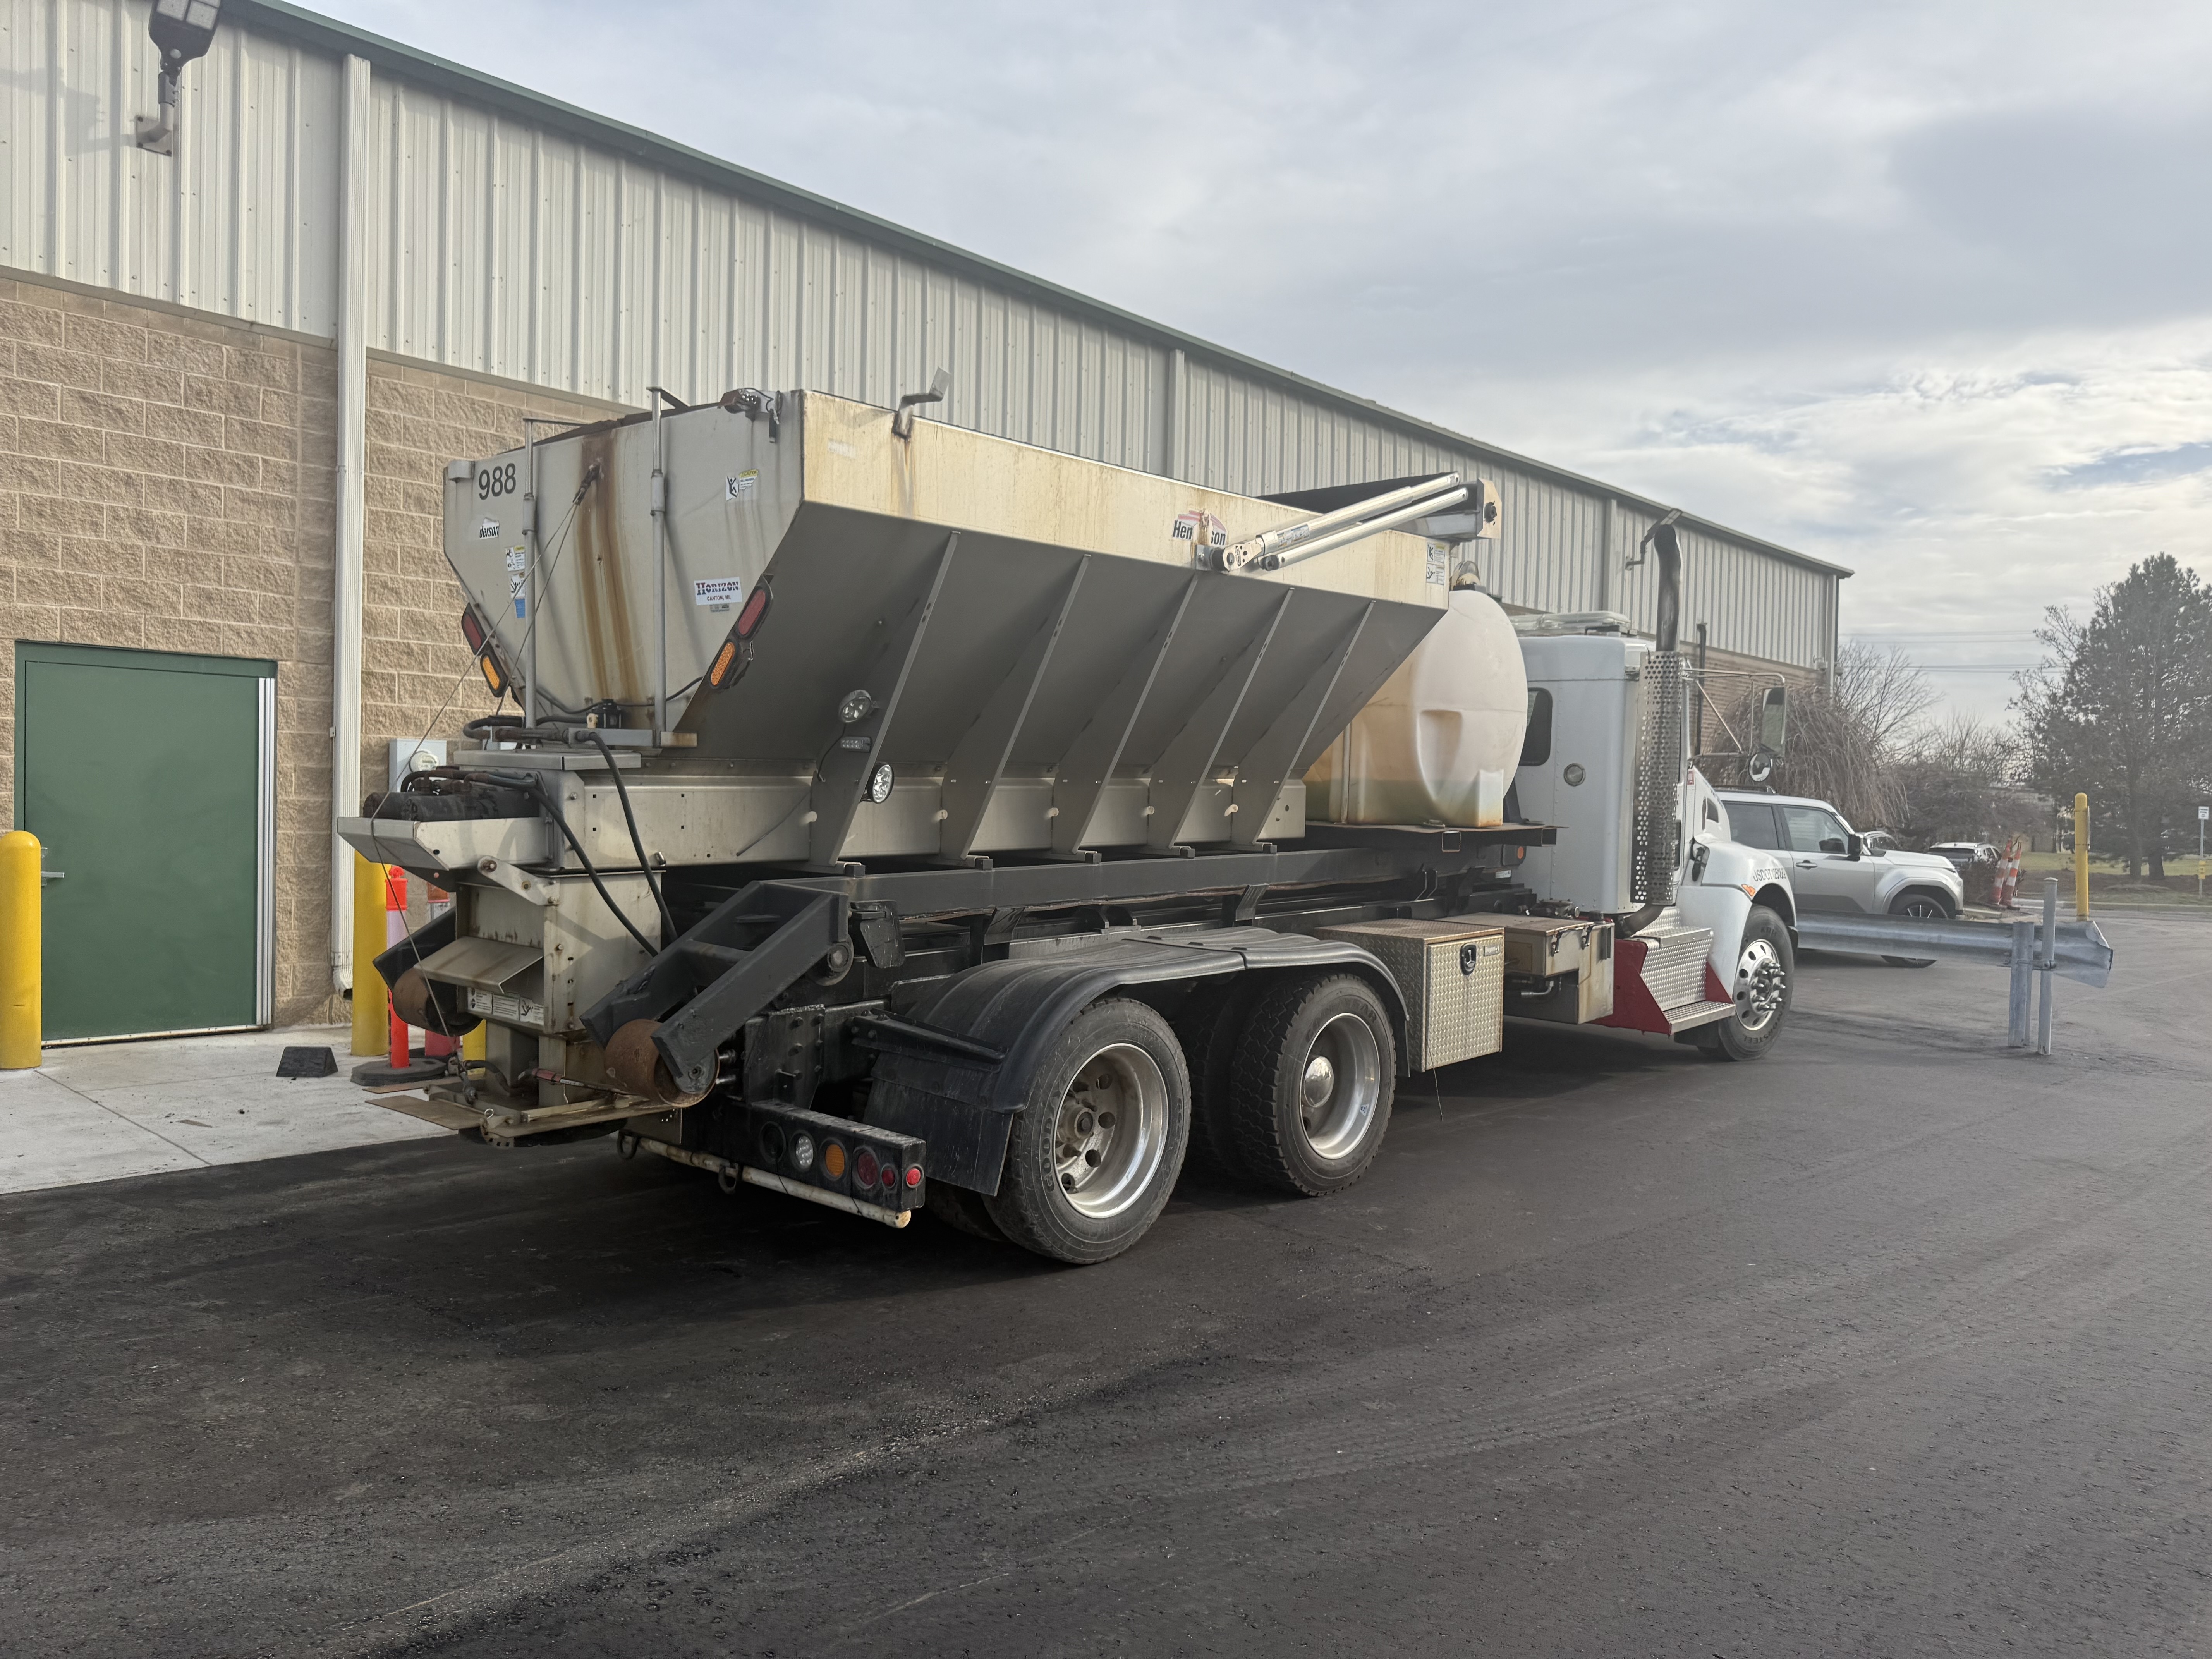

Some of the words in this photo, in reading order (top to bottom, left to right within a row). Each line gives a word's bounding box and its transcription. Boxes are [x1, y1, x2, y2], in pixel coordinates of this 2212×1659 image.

[479, 463, 516, 500] 988
[479, 526, 499, 538] derson
[696, 582, 738, 595] HORIZON
